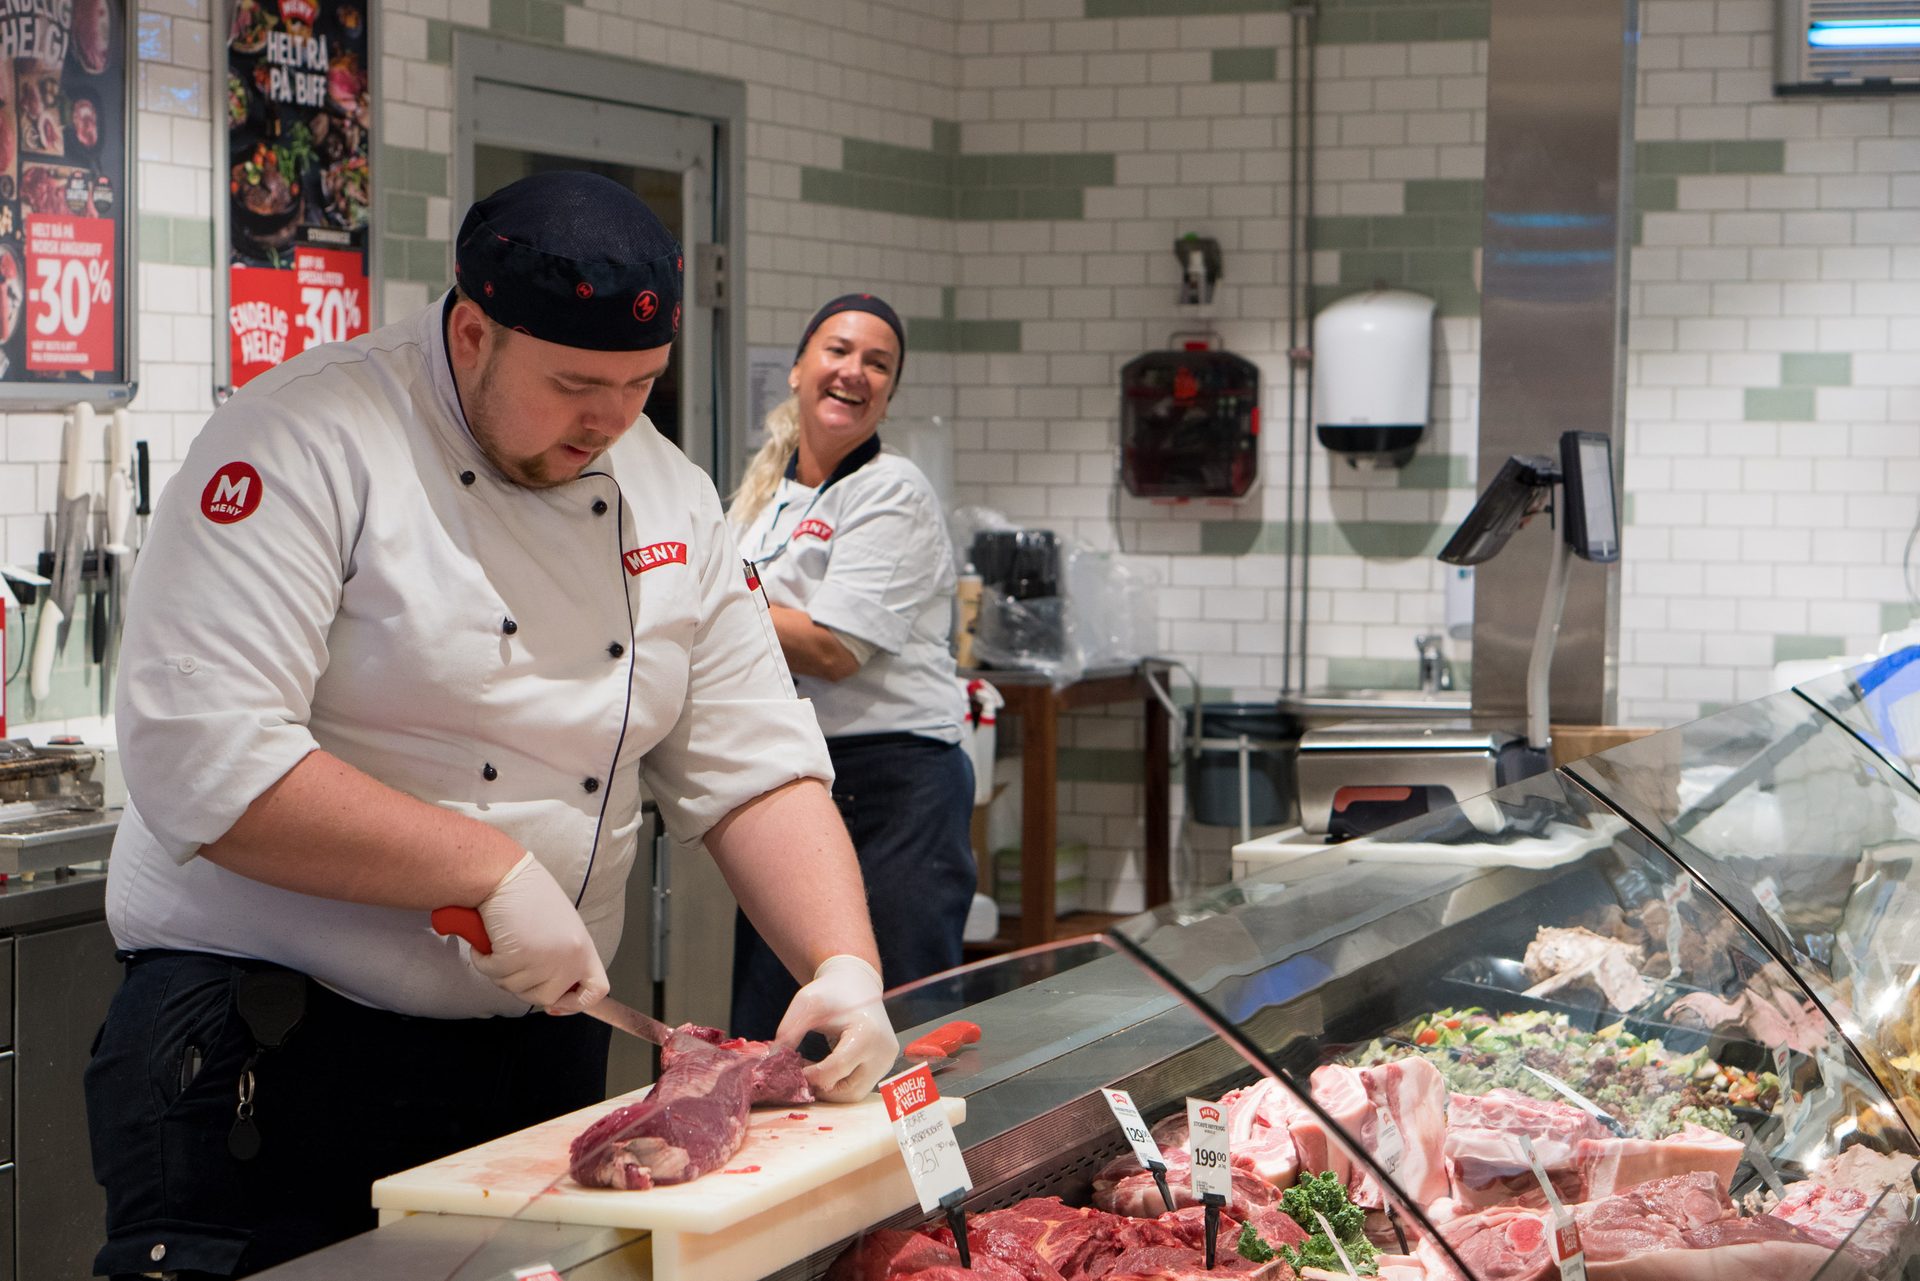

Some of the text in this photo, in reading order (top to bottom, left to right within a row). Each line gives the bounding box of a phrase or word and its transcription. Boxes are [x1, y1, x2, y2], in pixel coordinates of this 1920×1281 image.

[2, 16, 69, 67] HELG!
[267, 30, 329, 72] HELT RÅ
[270, 64, 326, 108] PÅ BIFF
[229, 301, 288, 338] ENDELIG
[240, 330, 287, 365] HELG!
[212, 475, 251, 508] M
[210, 503, 242, 516] MENY
[626, 544, 680, 572] MENY
[893, 1076, 926, 1100] ENDELIG
[900, 1089, 927, 1110] HELG!
